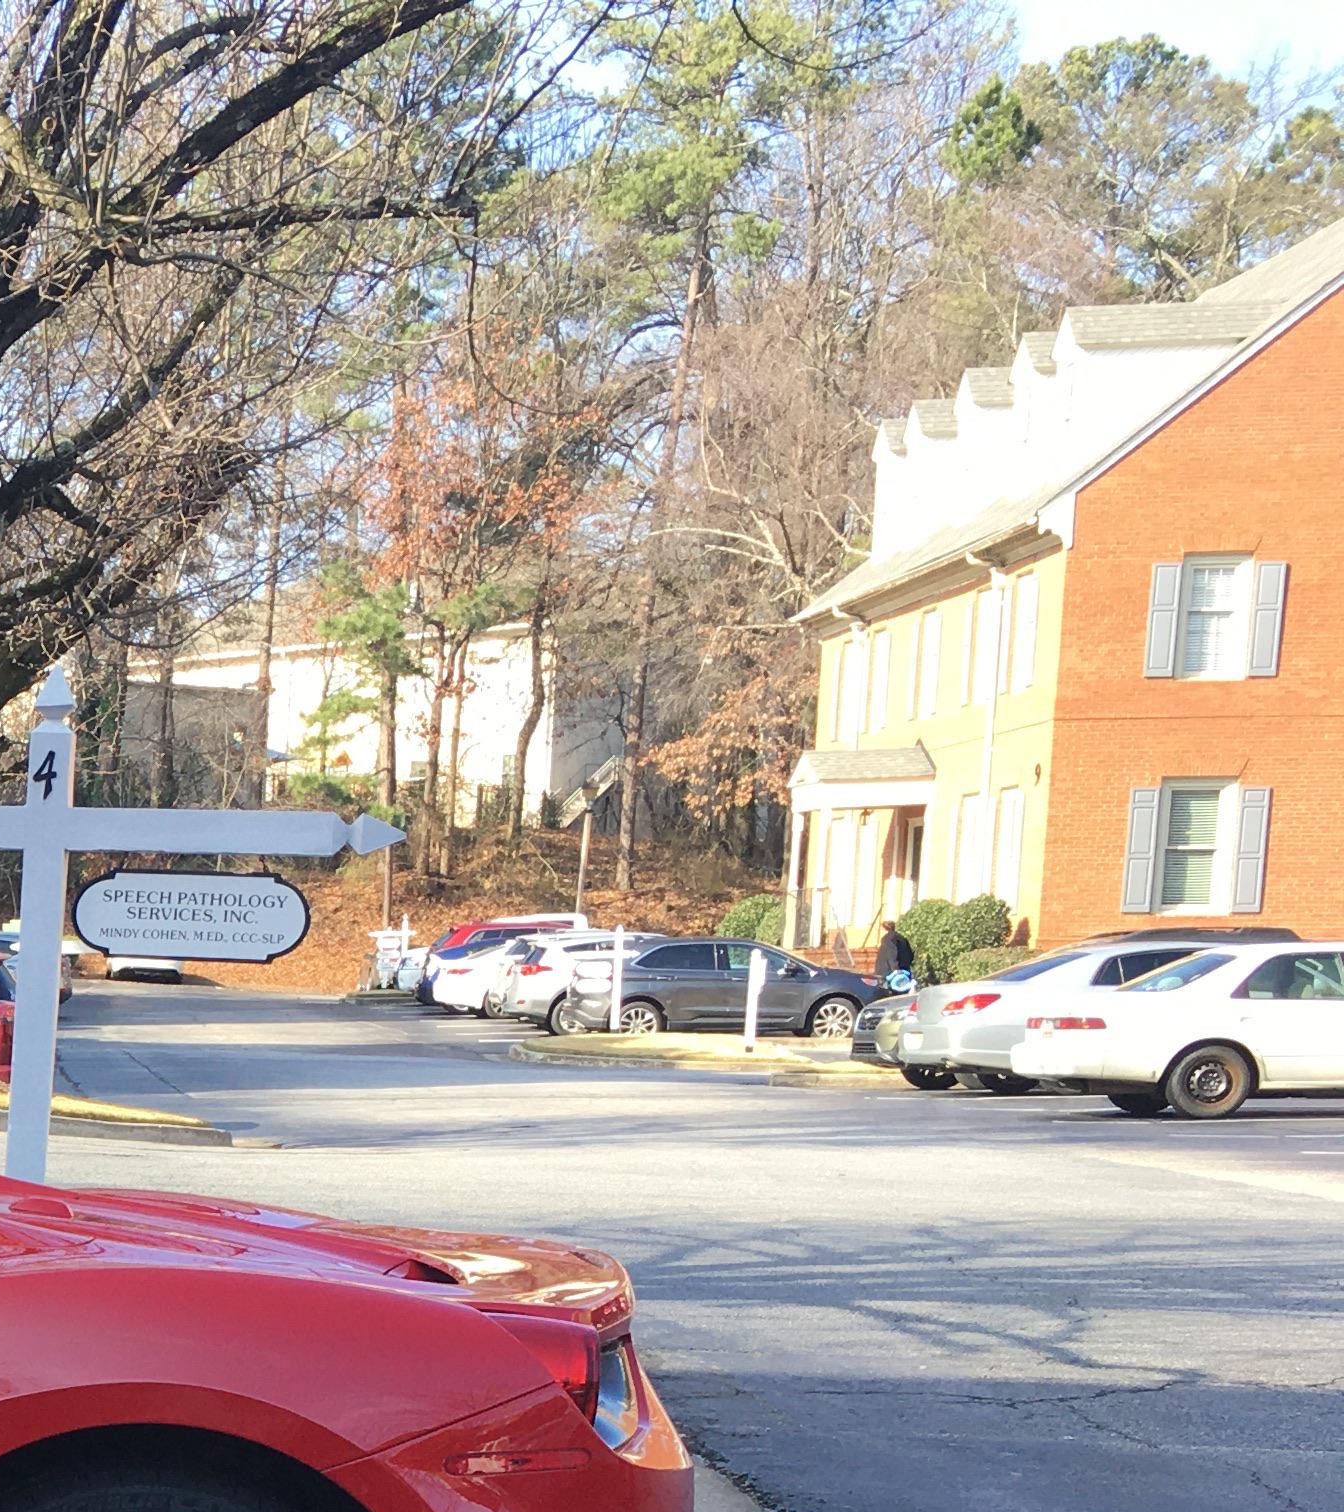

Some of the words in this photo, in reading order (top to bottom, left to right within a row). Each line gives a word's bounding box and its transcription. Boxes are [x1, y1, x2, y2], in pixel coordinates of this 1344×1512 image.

[32, 750, 57, 800] 4
[102, 888, 172, 905] SPEECH
[177, 891, 288, 909] PATHOLOGY
[126, 906, 217, 924] SERVICES,
[223, 909, 259, 924] INC.
[99, 927, 140, 939] MINDY
[231, 931, 286, 945] CCC-SLP
